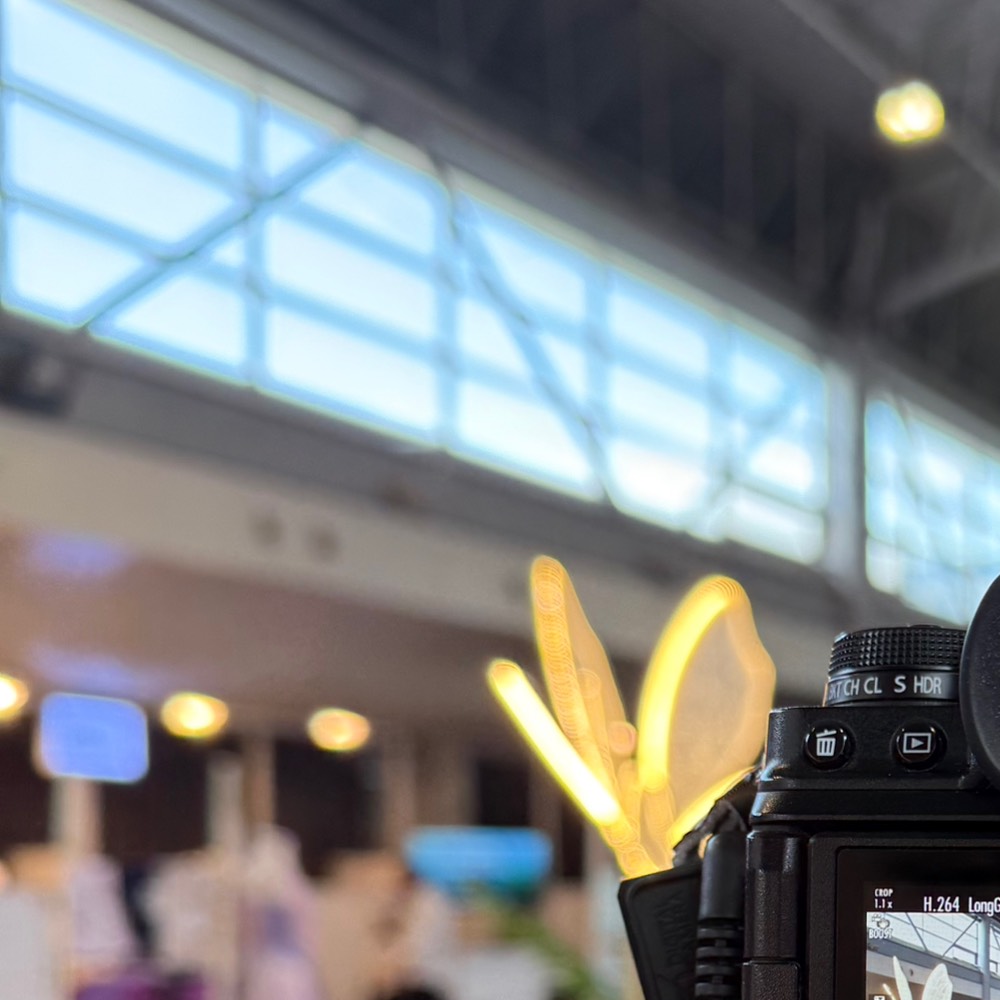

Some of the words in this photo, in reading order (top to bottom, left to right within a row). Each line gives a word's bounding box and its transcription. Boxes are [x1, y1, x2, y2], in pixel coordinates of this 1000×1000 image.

[844, 678, 860, 697] CH
[864, 677, 883, 695] CL
[894, 675, 907, 694] S
[913, 675, 942, 695] HDR
[874, 888, 894, 897] CROP
[923, 896, 960, 913] H.264
